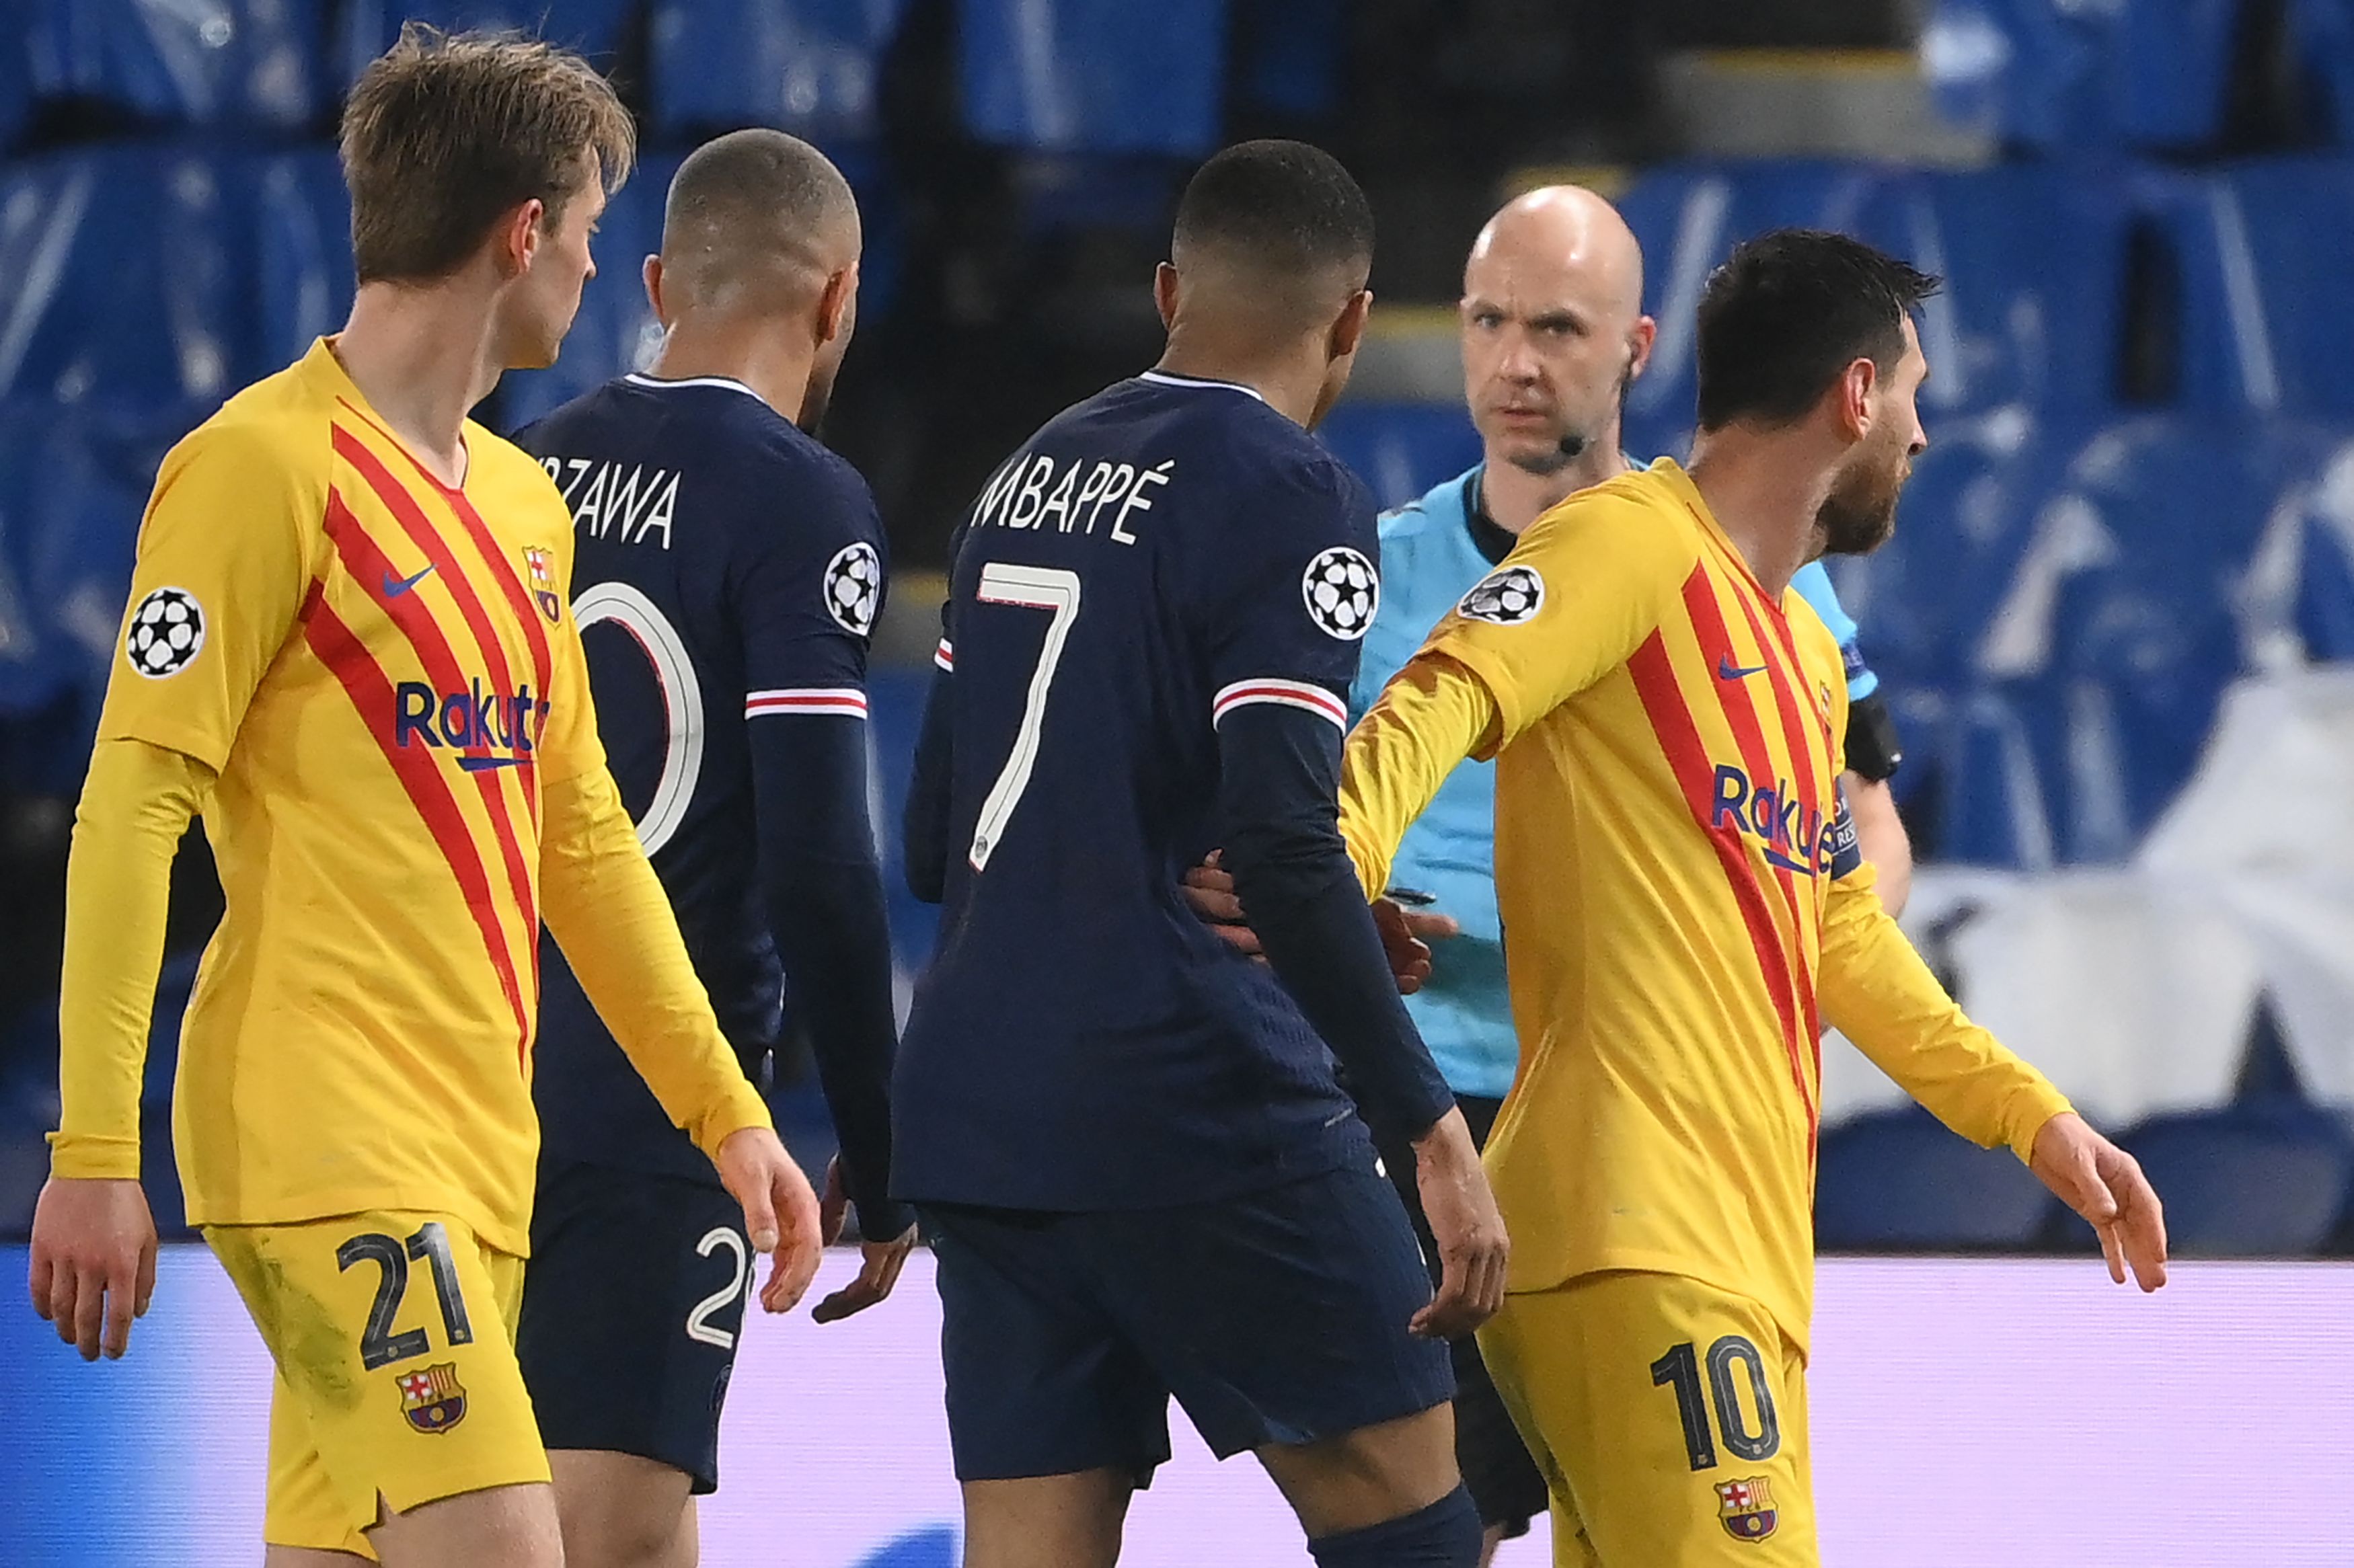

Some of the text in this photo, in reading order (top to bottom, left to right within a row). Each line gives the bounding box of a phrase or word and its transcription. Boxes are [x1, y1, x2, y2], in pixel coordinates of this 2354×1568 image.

[971, 452, 1175, 545] MBAPPÉ
[395, 676, 550, 751] Rakut
[969, 562, 1081, 873] 7
[336, 1222, 473, 1371] 21
[686, 1226, 756, 1349] 2
[1650, 1335, 1780, 1471] 10
